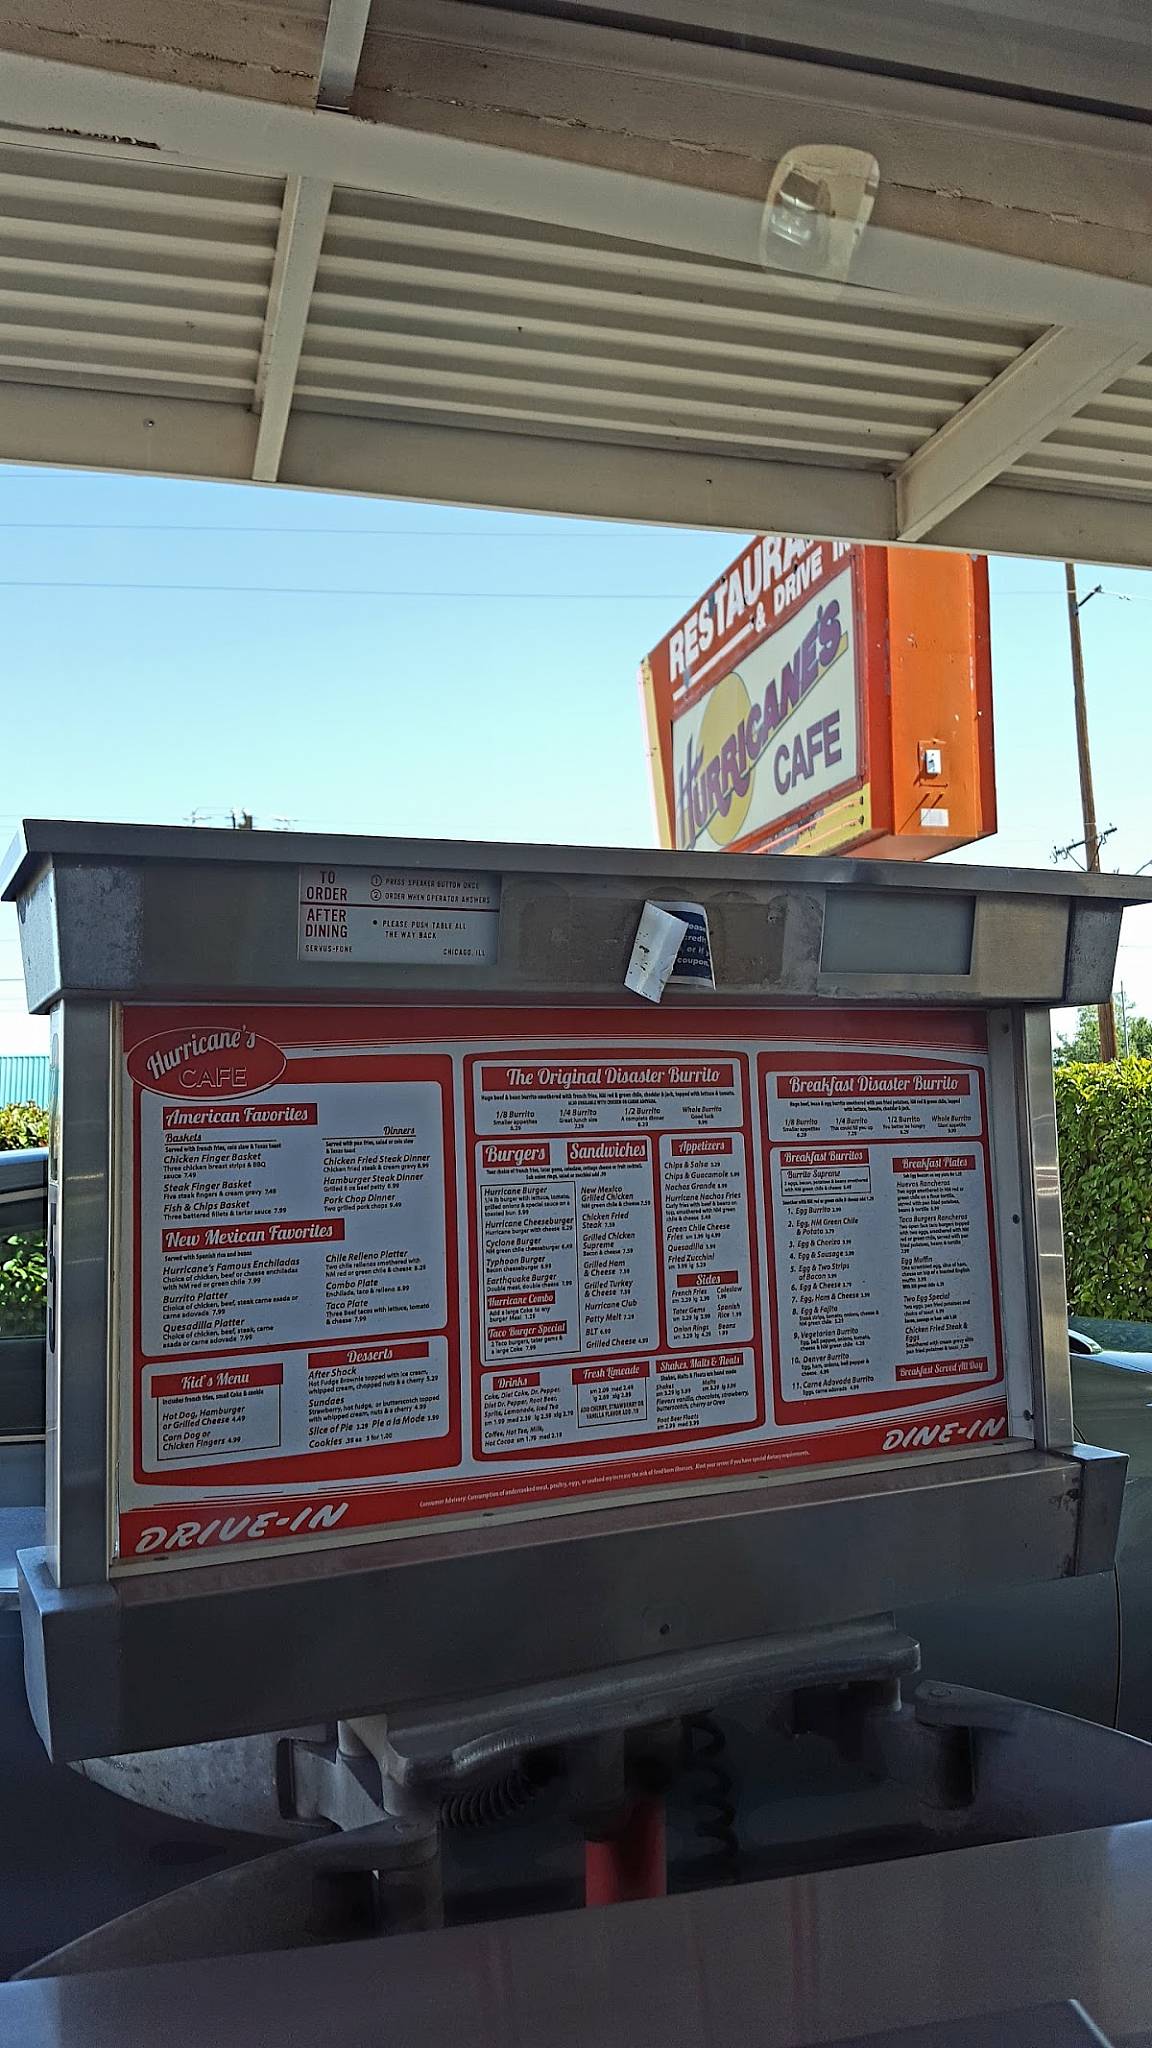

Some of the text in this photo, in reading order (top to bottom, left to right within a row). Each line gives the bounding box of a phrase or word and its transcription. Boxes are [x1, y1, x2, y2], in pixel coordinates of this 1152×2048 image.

[755, 602, 767, 633] &
[773, 545, 823, 616] DRIVE
[674, 599, 841, 850] HURRICANE'S
[773, 710, 842, 795] CAFE
[320, 871, 335, 884] TO
[408, 880, 434, 888] SPEAKER
[438, 880, 460, 888] BUTTON
[306, 887, 348, 901] ORDER
[427, 894, 458, 902] OPERATOR
[307, 909, 346, 922] AFTER
[383, 920, 407, 928] PLEASE
[306, 924, 348, 937] DINING
[146, 1025, 256, 1080] Hurricane's
[179, 1067, 247, 1088] CAFE
[507, 1066, 720, 1089] The Original Disaster Burrito
[789, 1075, 959, 1096] Breakfast Disaster Burrito
[166, 1107, 308, 1126] American Favorites
[496, 1111, 507, 1119] 1/8
[572, 1108, 597, 1116] Burrito
[384, 1126, 415, 1135] Dinners
[165, 1133, 202, 1142] Baskets
[569, 1142, 646, 1160] Sandwiches
[679, 1140, 724, 1154] Appetizers
[164, 1152, 261, 1164] Chicken Finger Basket
[324, 1157, 355, 1166] Chicken
[358, 1156, 377, 1164] Fried
[380, 1155, 401, 1163] Steak
[486, 1145, 545, 1165] Burgers
[784, 1151, 863, 1164] Breakfast Burritos
[902, 1158, 967, 1170] Breakfast Plates
[163, 1180, 252, 1192] Steak Finger Basket
[324, 1176, 370, 1185] Hamburger
[484, 1188, 520, 1196] Hurricane
[324, 1196, 343, 1204] Pork
[345, 1196, 366, 1204] Chop
[164, 1201, 250, 1212] Fish & Chips Basket
[485, 1217, 574, 1228] Hurricane Cheeseburger
[166, 1224, 333, 1247] New Mexican Favorites
[486, 1238, 541, 1248] Cyclone Burger
[326, 1250, 408, 1263] Chile Relleno Platter
[487, 1258, 519, 1267] Typhoon
[163, 1258, 300, 1275] Hurricane's Famous Enchiladas
[326, 1281, 355, 1290] Combo
[487, 1274, 556, 1285] Earthquake Burger
[696, 1274, 720, 1285] Sides
[163, 1292, 228, 1304] Burrito Platter
[326, 1300, 368, 1310] Taco Plate
[585, 1299, 637, 1310] Hurricane Club
[163, 1319, 245, 1333] Quesadilla Platter
[586, 1340, 610, 1348] Grilled
[347, 1349, 393, 1363] Desserts
[308, 1367, 356, 1379] After Shock
[583, 1365, 640, 1379] Fresh Limeade
[900, 1366, 933, 1377] Breakfast
[935, 1363, 957, 1374] Served
[181, 1373, 249, 1389] Kid's Menu
[498, 1377, 527, 1389] Drinks
[308, 1397, 344, 1408] Sundaes
[163, 1413, 178, 1421] Hot
[200, 1407, 245, 1417] Hamburger
[308, 1424, 353, 1436] Slice of Pie
[882, 1417, 1005, 1450] DINE-IN
[163, 1438, 226, 1451] Chicken Fingers
[308, 1439, 342, 1448] Cookies
[136, 1502, 348, 1553] DRIVE-IN
